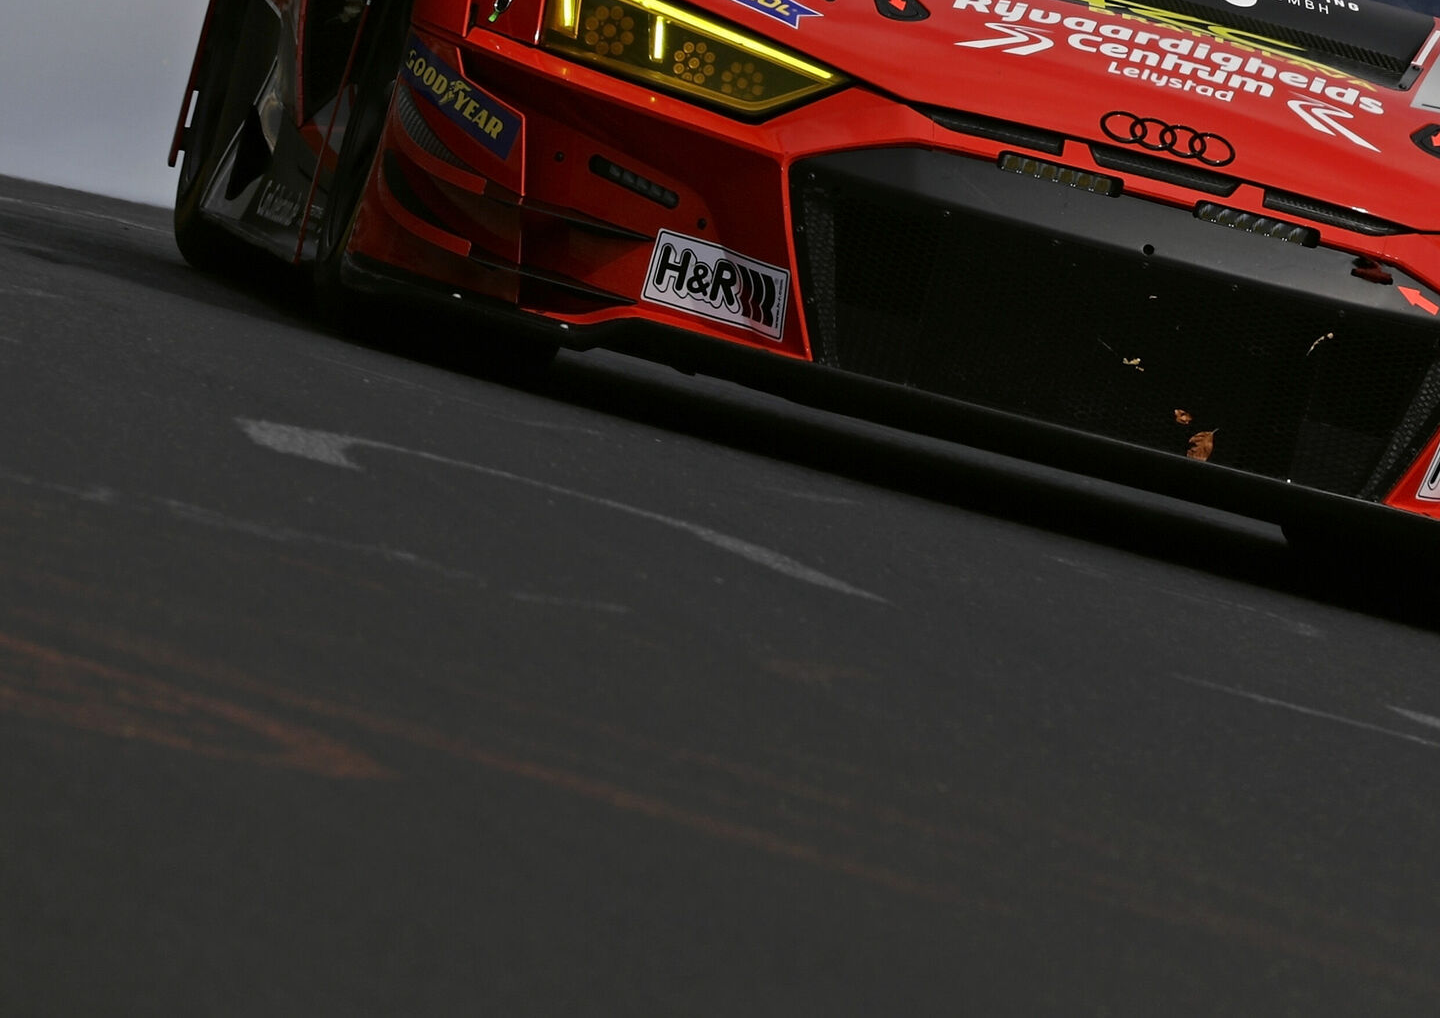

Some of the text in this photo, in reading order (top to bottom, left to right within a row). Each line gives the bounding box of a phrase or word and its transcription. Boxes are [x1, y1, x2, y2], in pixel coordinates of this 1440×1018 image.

[1066, 33, 1275, 98] Centrum
[1107, 61, 1234, 103] Lelystad
[655, 245, 737, 307] H&R
